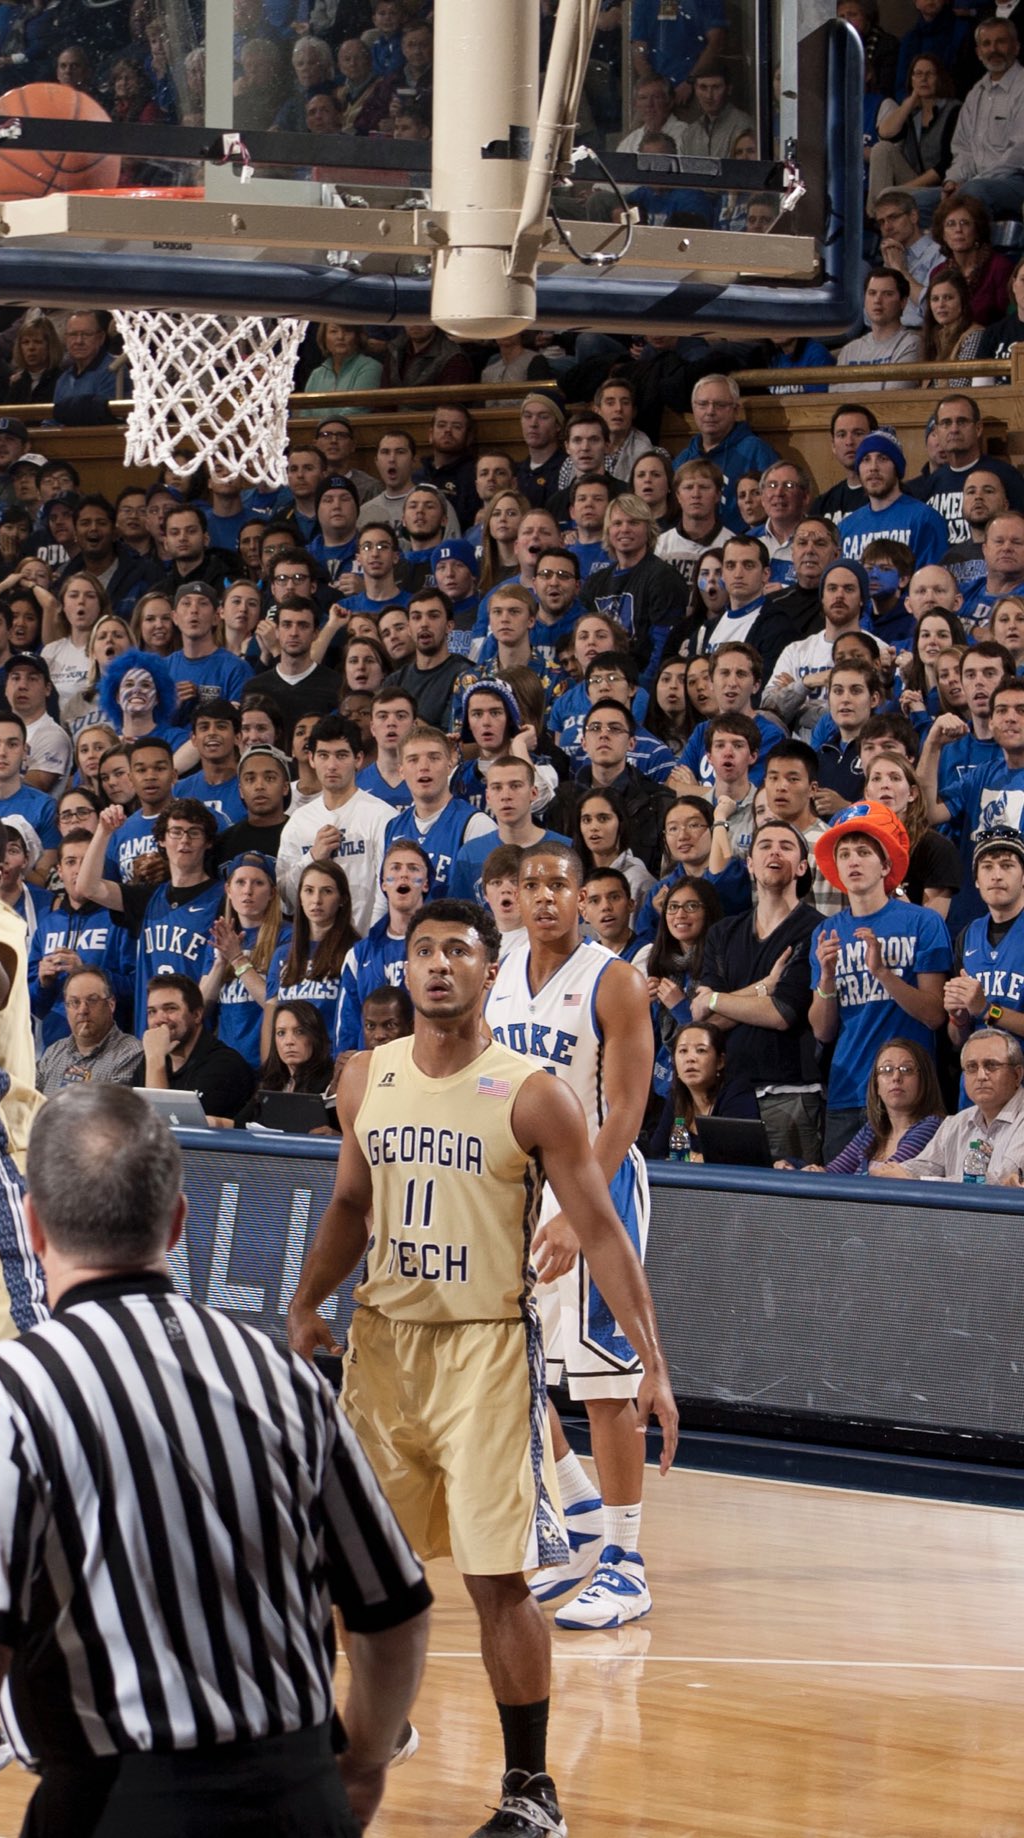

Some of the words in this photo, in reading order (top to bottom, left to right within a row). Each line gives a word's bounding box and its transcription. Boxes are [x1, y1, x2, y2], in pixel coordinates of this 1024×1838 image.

[153, 241, 192, 250] BACKBOARD
[37, 545, 70, 565] DUK
[119, 835, 159, 861] CAME
[45, 929, 108, 955] DUKE
[145, 925, 206, 961] DUKE
[976, 970, 1024, 1001] UKE
[493, 1022, 578, 1066] DUKE
[367, 1125, 483, 1175] GEORGIA
[403, 1178, 435, 1229] 11
[387, 1238, 469, 1284] TECH
